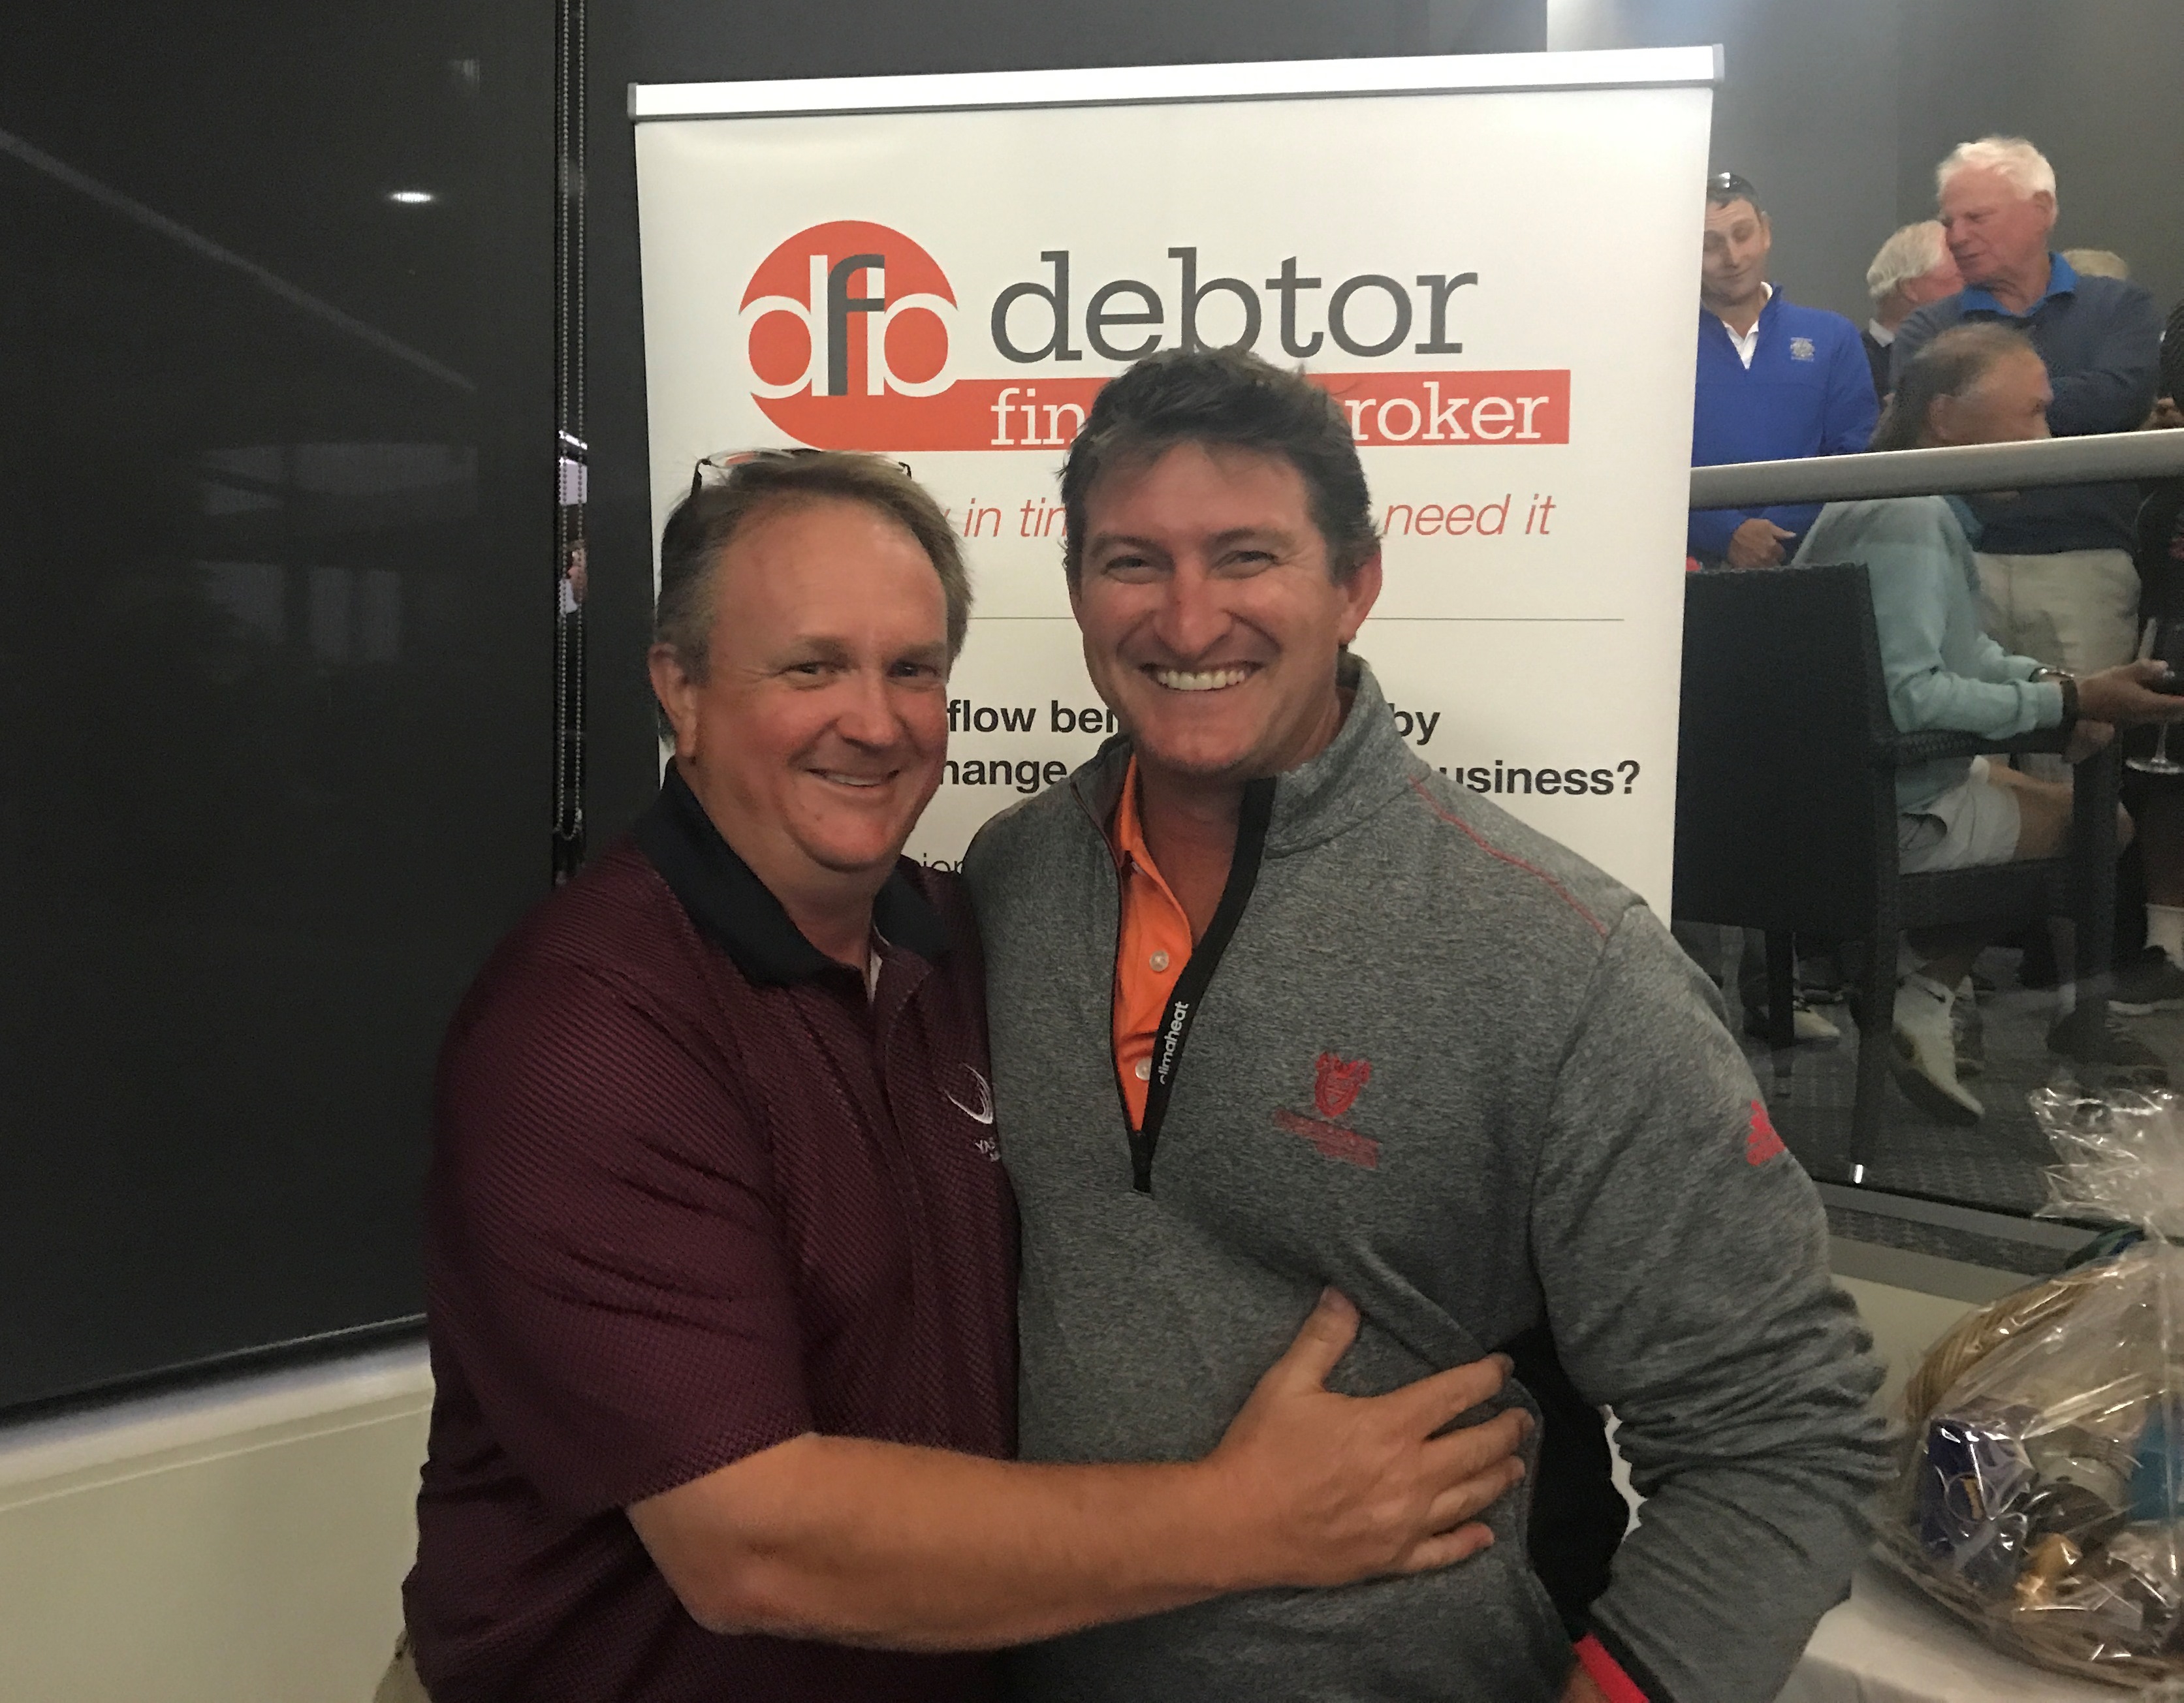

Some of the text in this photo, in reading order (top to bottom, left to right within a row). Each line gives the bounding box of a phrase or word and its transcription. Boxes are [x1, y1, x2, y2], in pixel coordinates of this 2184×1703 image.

[990, 245, 1478, 364] debtor
[963, 497, 1002, 538] in
[1383, 493, 1511, 536] need
[1525, 493, 1557, 535] it
[946, 699, 1037, 732] flow
[1158, 1001, 1190, 1085] climaheat
